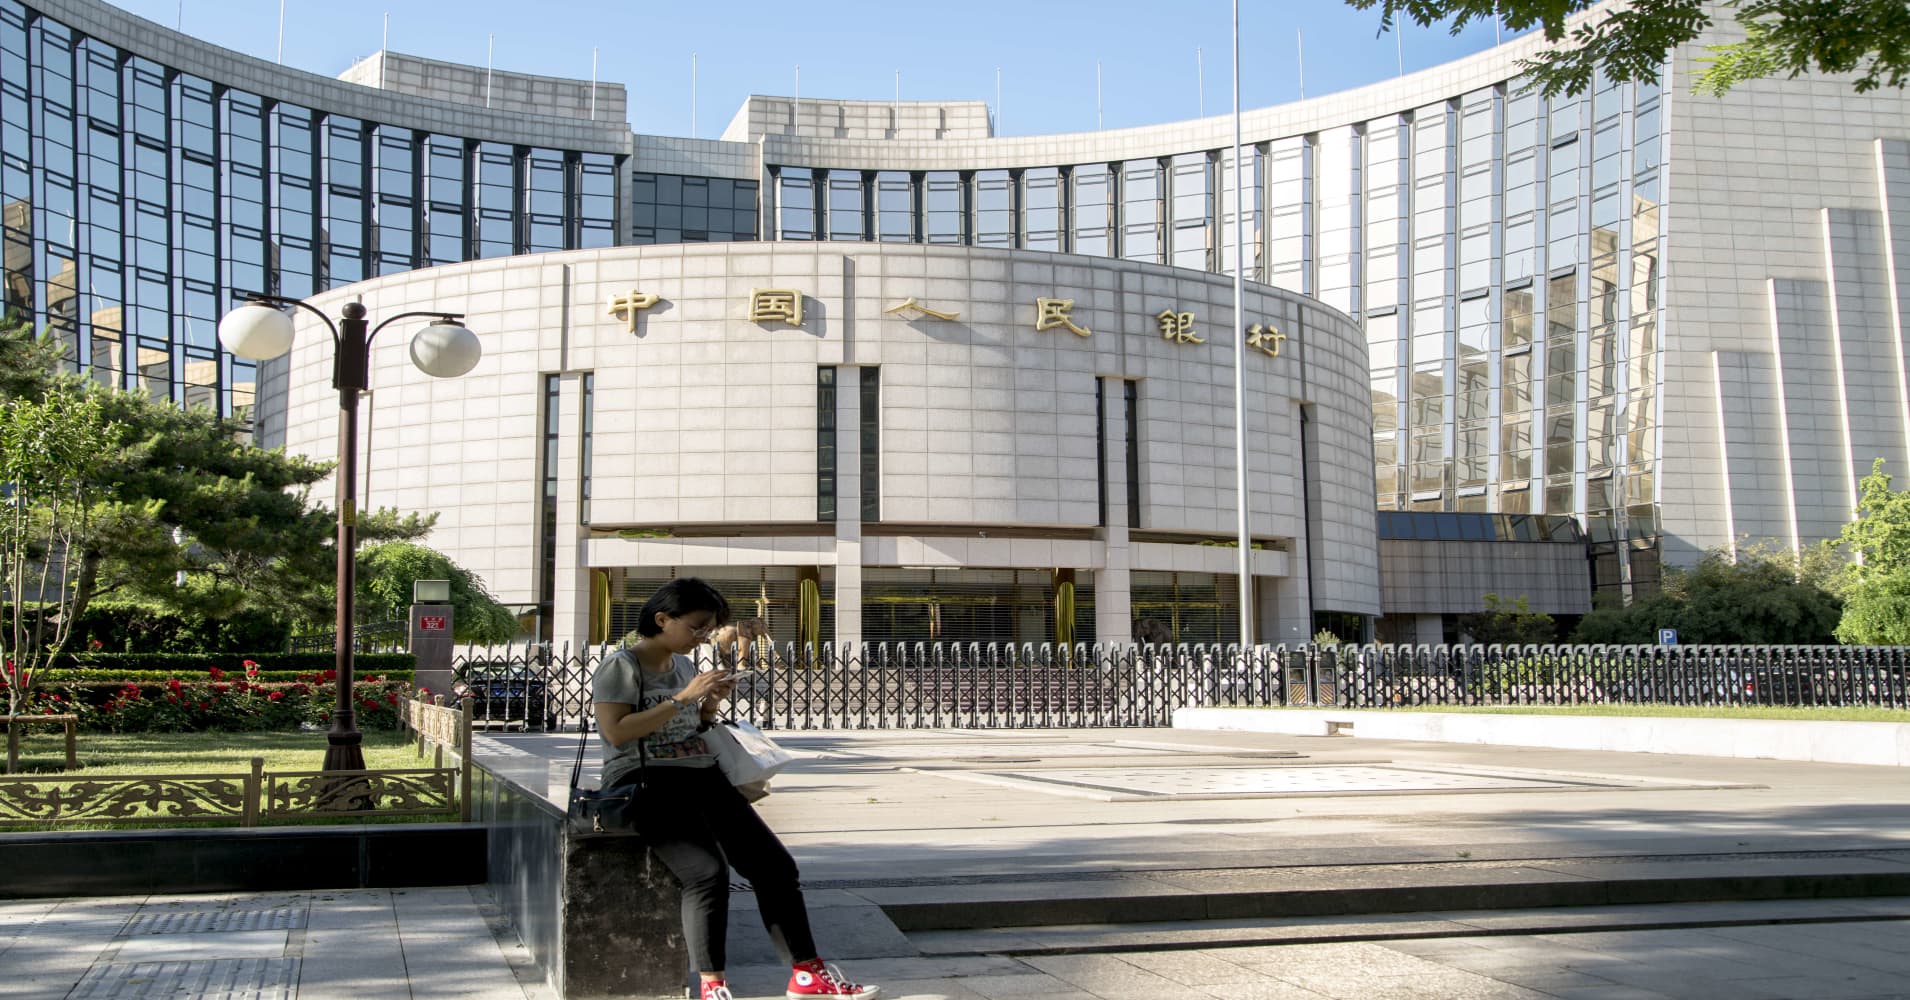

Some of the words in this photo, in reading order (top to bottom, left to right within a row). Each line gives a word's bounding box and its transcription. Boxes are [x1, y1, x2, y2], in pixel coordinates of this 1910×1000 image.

[607, 287, 1287, 357] 中国人民银行
[1663, 630, 1673, 643] P
